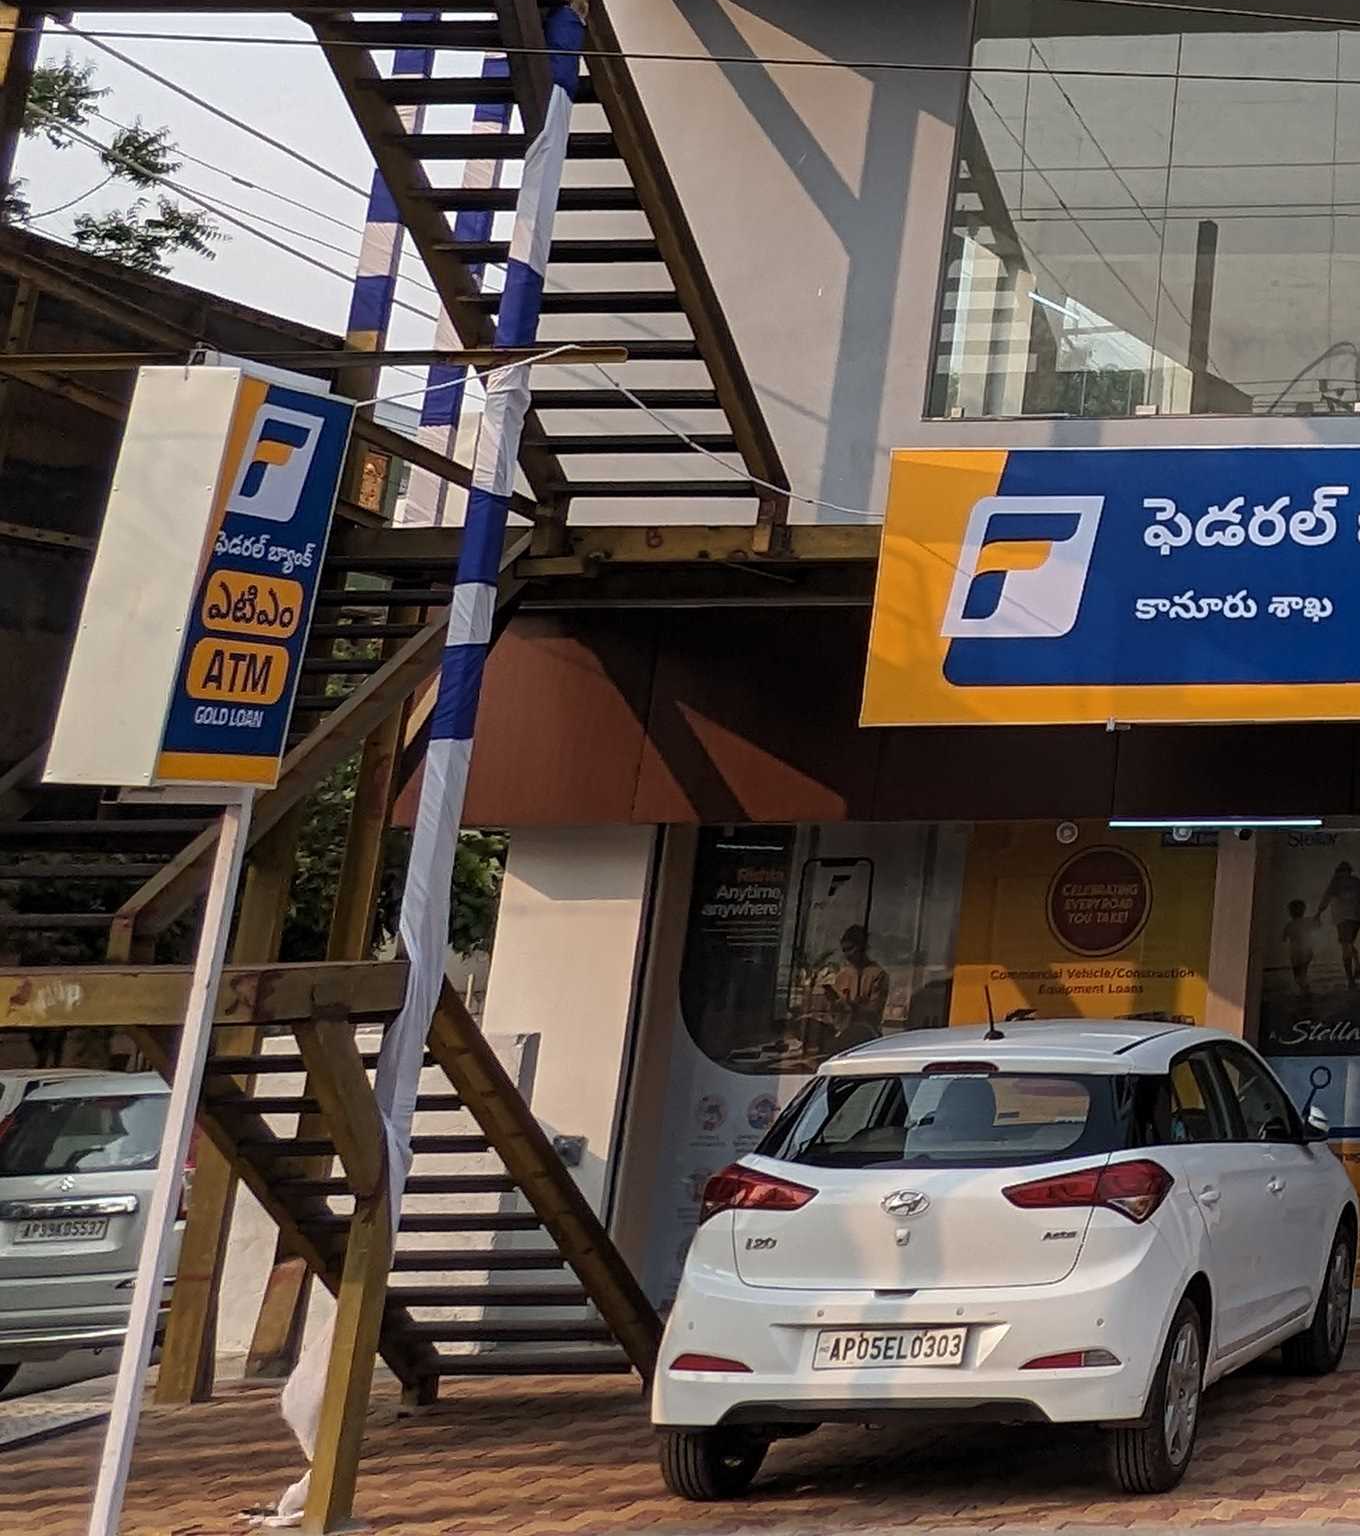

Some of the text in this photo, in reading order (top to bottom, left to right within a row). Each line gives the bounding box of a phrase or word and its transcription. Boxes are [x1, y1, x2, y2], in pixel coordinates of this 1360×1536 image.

[1142, 485, 1349, 555] ఫెడరల్
[215, 531, 316, 574] ఫెడరల్ బ్యాంక్
[208, 580, 294, 628] ఎటిఎం
[1135, 590, 1333, 622] కానూరు శాఖ
[202, 649, 273, 695] ATM
[194, 706, 264, 728] GOLD LOAN
[828, 1332, 962, 1362] AP05EL0303
